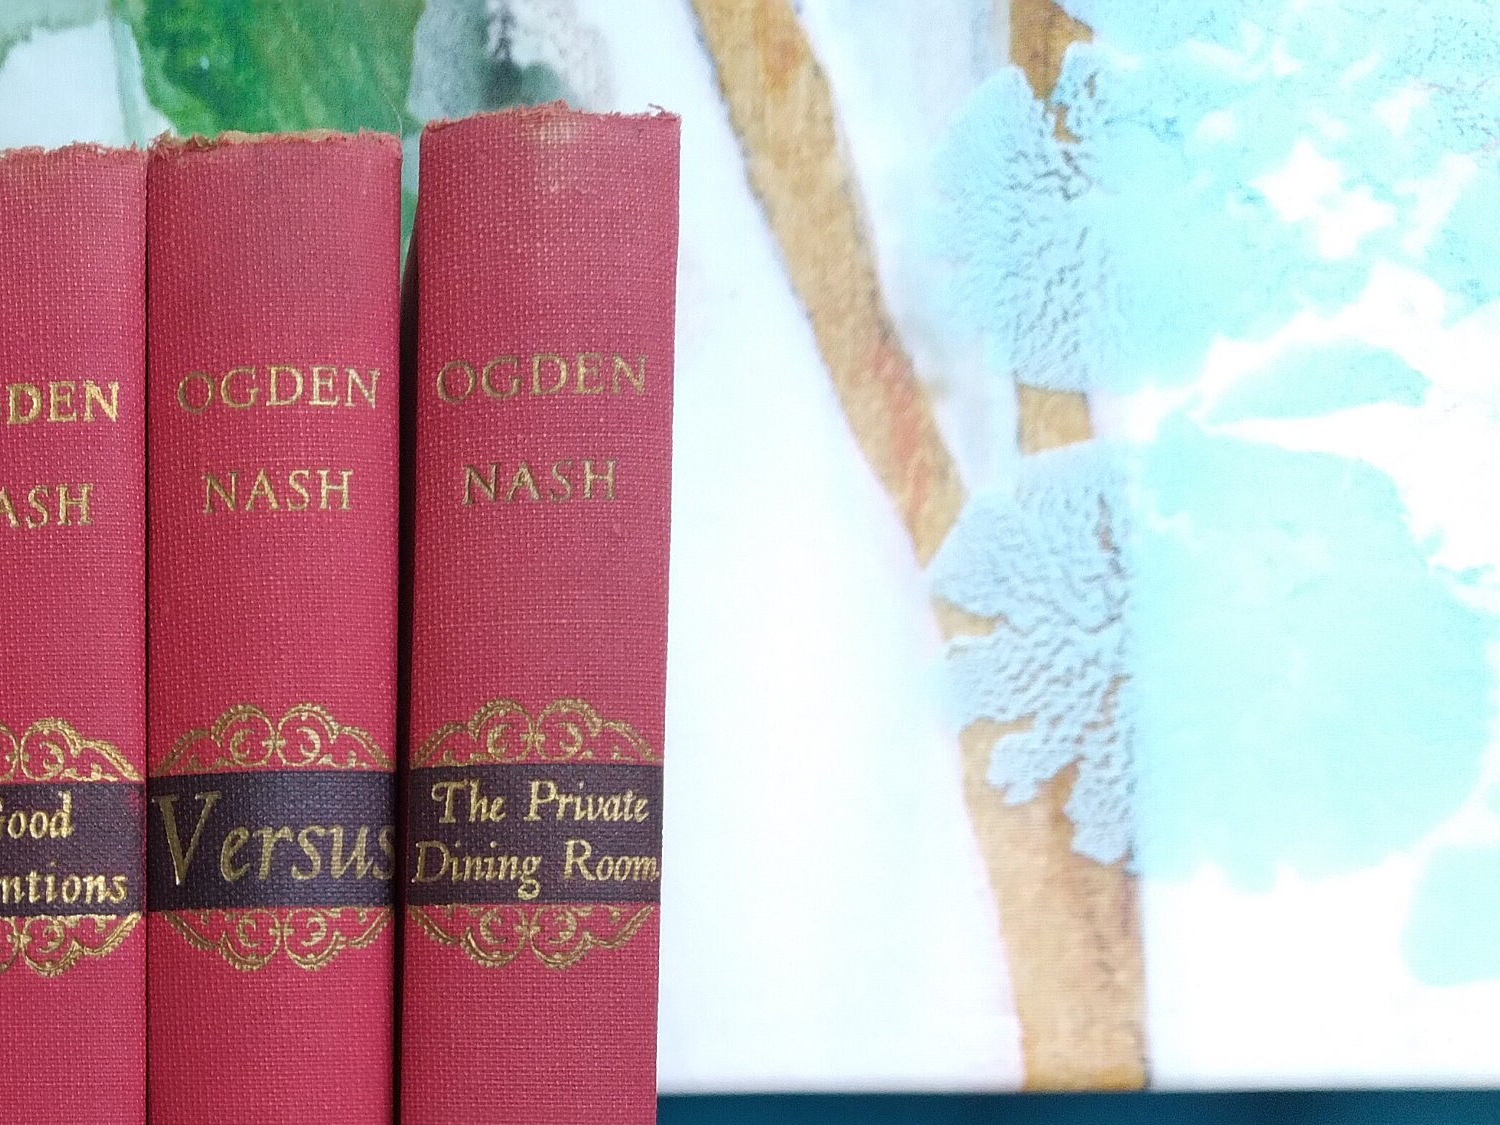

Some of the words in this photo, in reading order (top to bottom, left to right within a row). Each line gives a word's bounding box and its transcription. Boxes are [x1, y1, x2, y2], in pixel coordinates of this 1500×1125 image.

[177, 365, 380, 414] OGDEN
[436, 353, 648, 404] OGDEN
[201, 469, 354, 515] NASH
[462, 459, 617, 507] NASH
[431, 780, 506, 826] The
[523, 779, 649, 825] Private
[152, 792, 395, 886] Versus
[411, 839, 542, 901] Dining
[563, 838, 660, 883] Room
